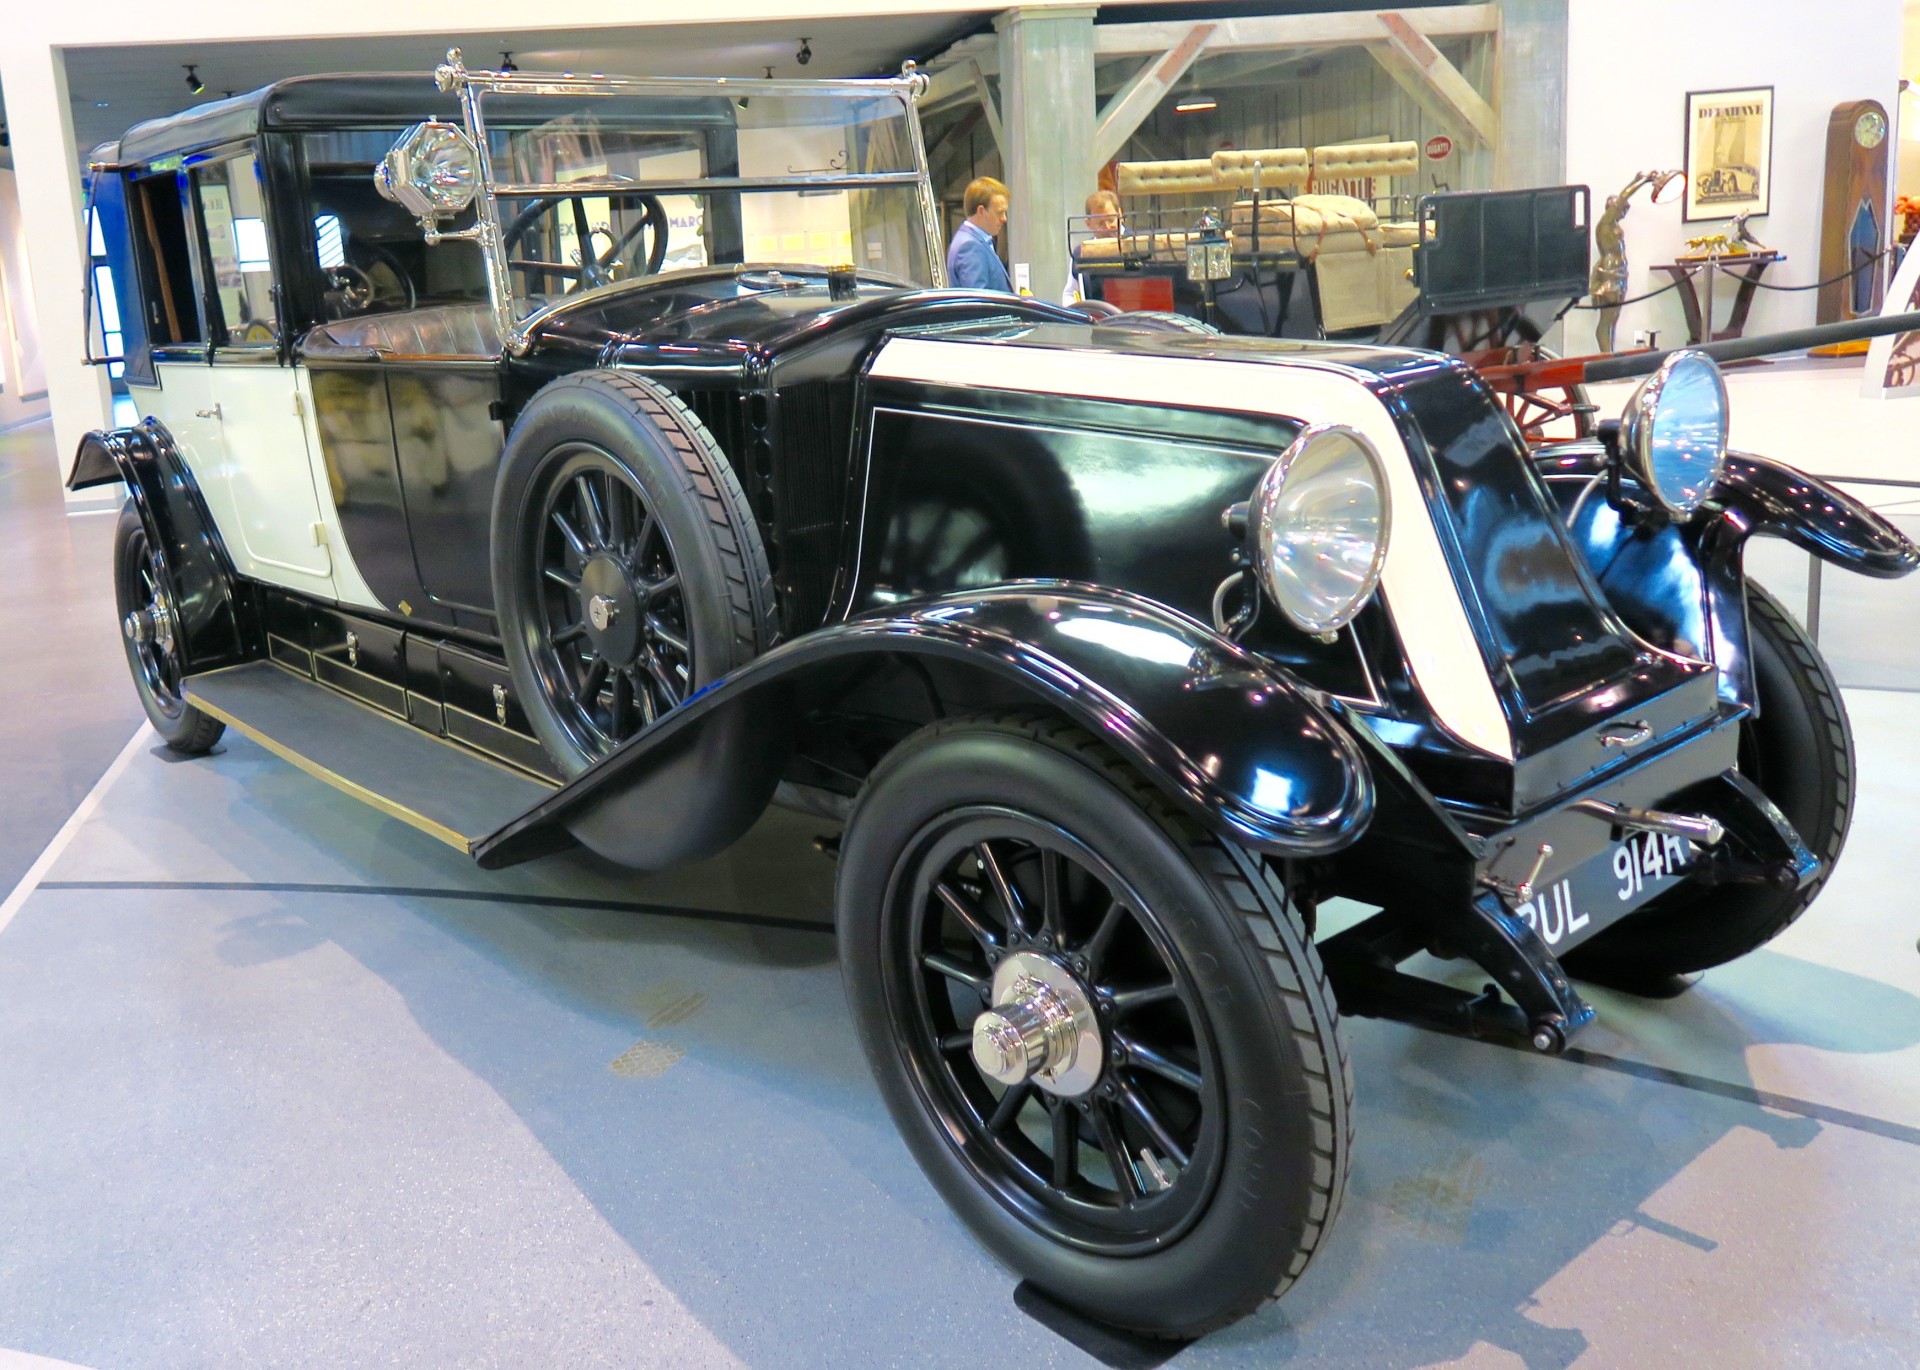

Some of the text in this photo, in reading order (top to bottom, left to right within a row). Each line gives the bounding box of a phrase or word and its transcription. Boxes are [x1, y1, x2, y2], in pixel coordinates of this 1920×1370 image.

[1698, 104, 1763, 118] DELAHAYE
[1426, 142, 1449, 155] BUGATTI
[1312, 177, 1366, 199] BUGATTI
